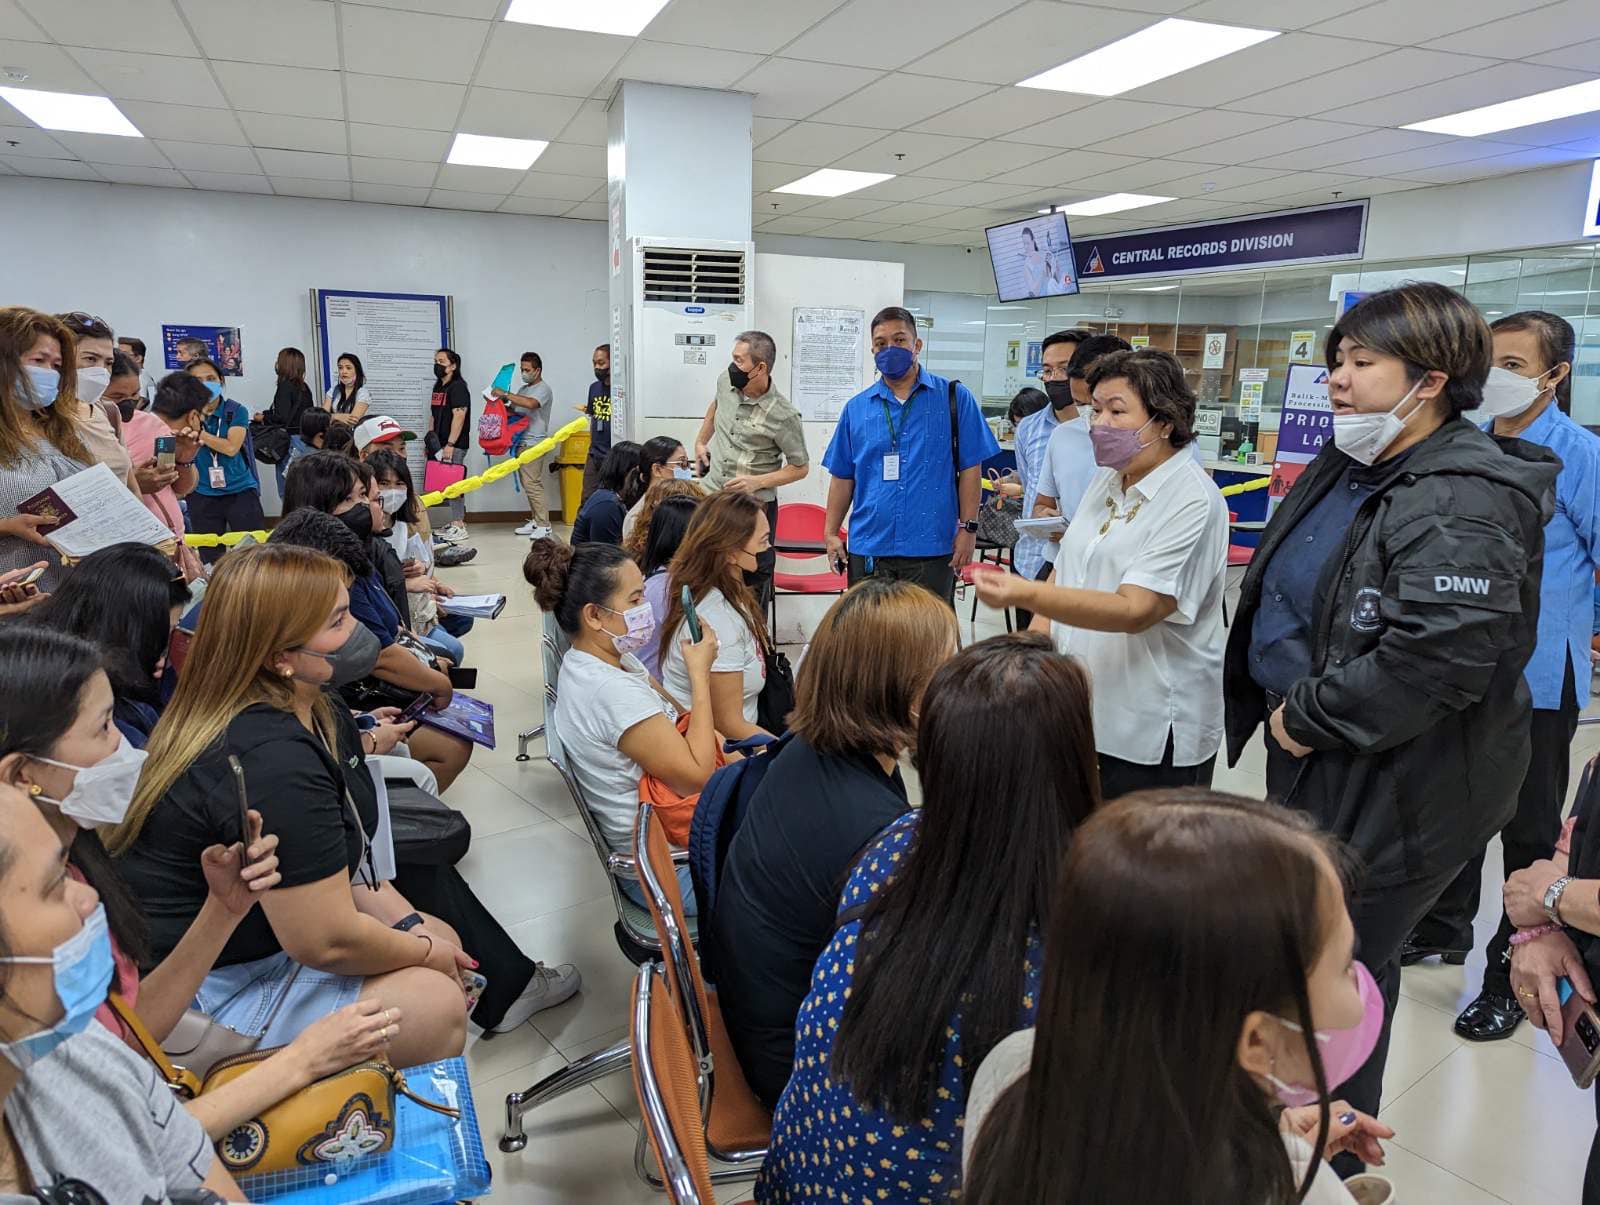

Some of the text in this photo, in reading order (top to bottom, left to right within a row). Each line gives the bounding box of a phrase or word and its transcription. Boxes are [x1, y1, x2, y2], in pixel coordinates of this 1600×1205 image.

[1112, 232, 1294, 265] CENTRAL RECORDS DIVISION
[1010, 347, 1016, 360] 1
[1295, 341, 1308, 358] 4
[1302, 433, 1331, 447] LA
[1434, 575, 1490, 595] DMW
